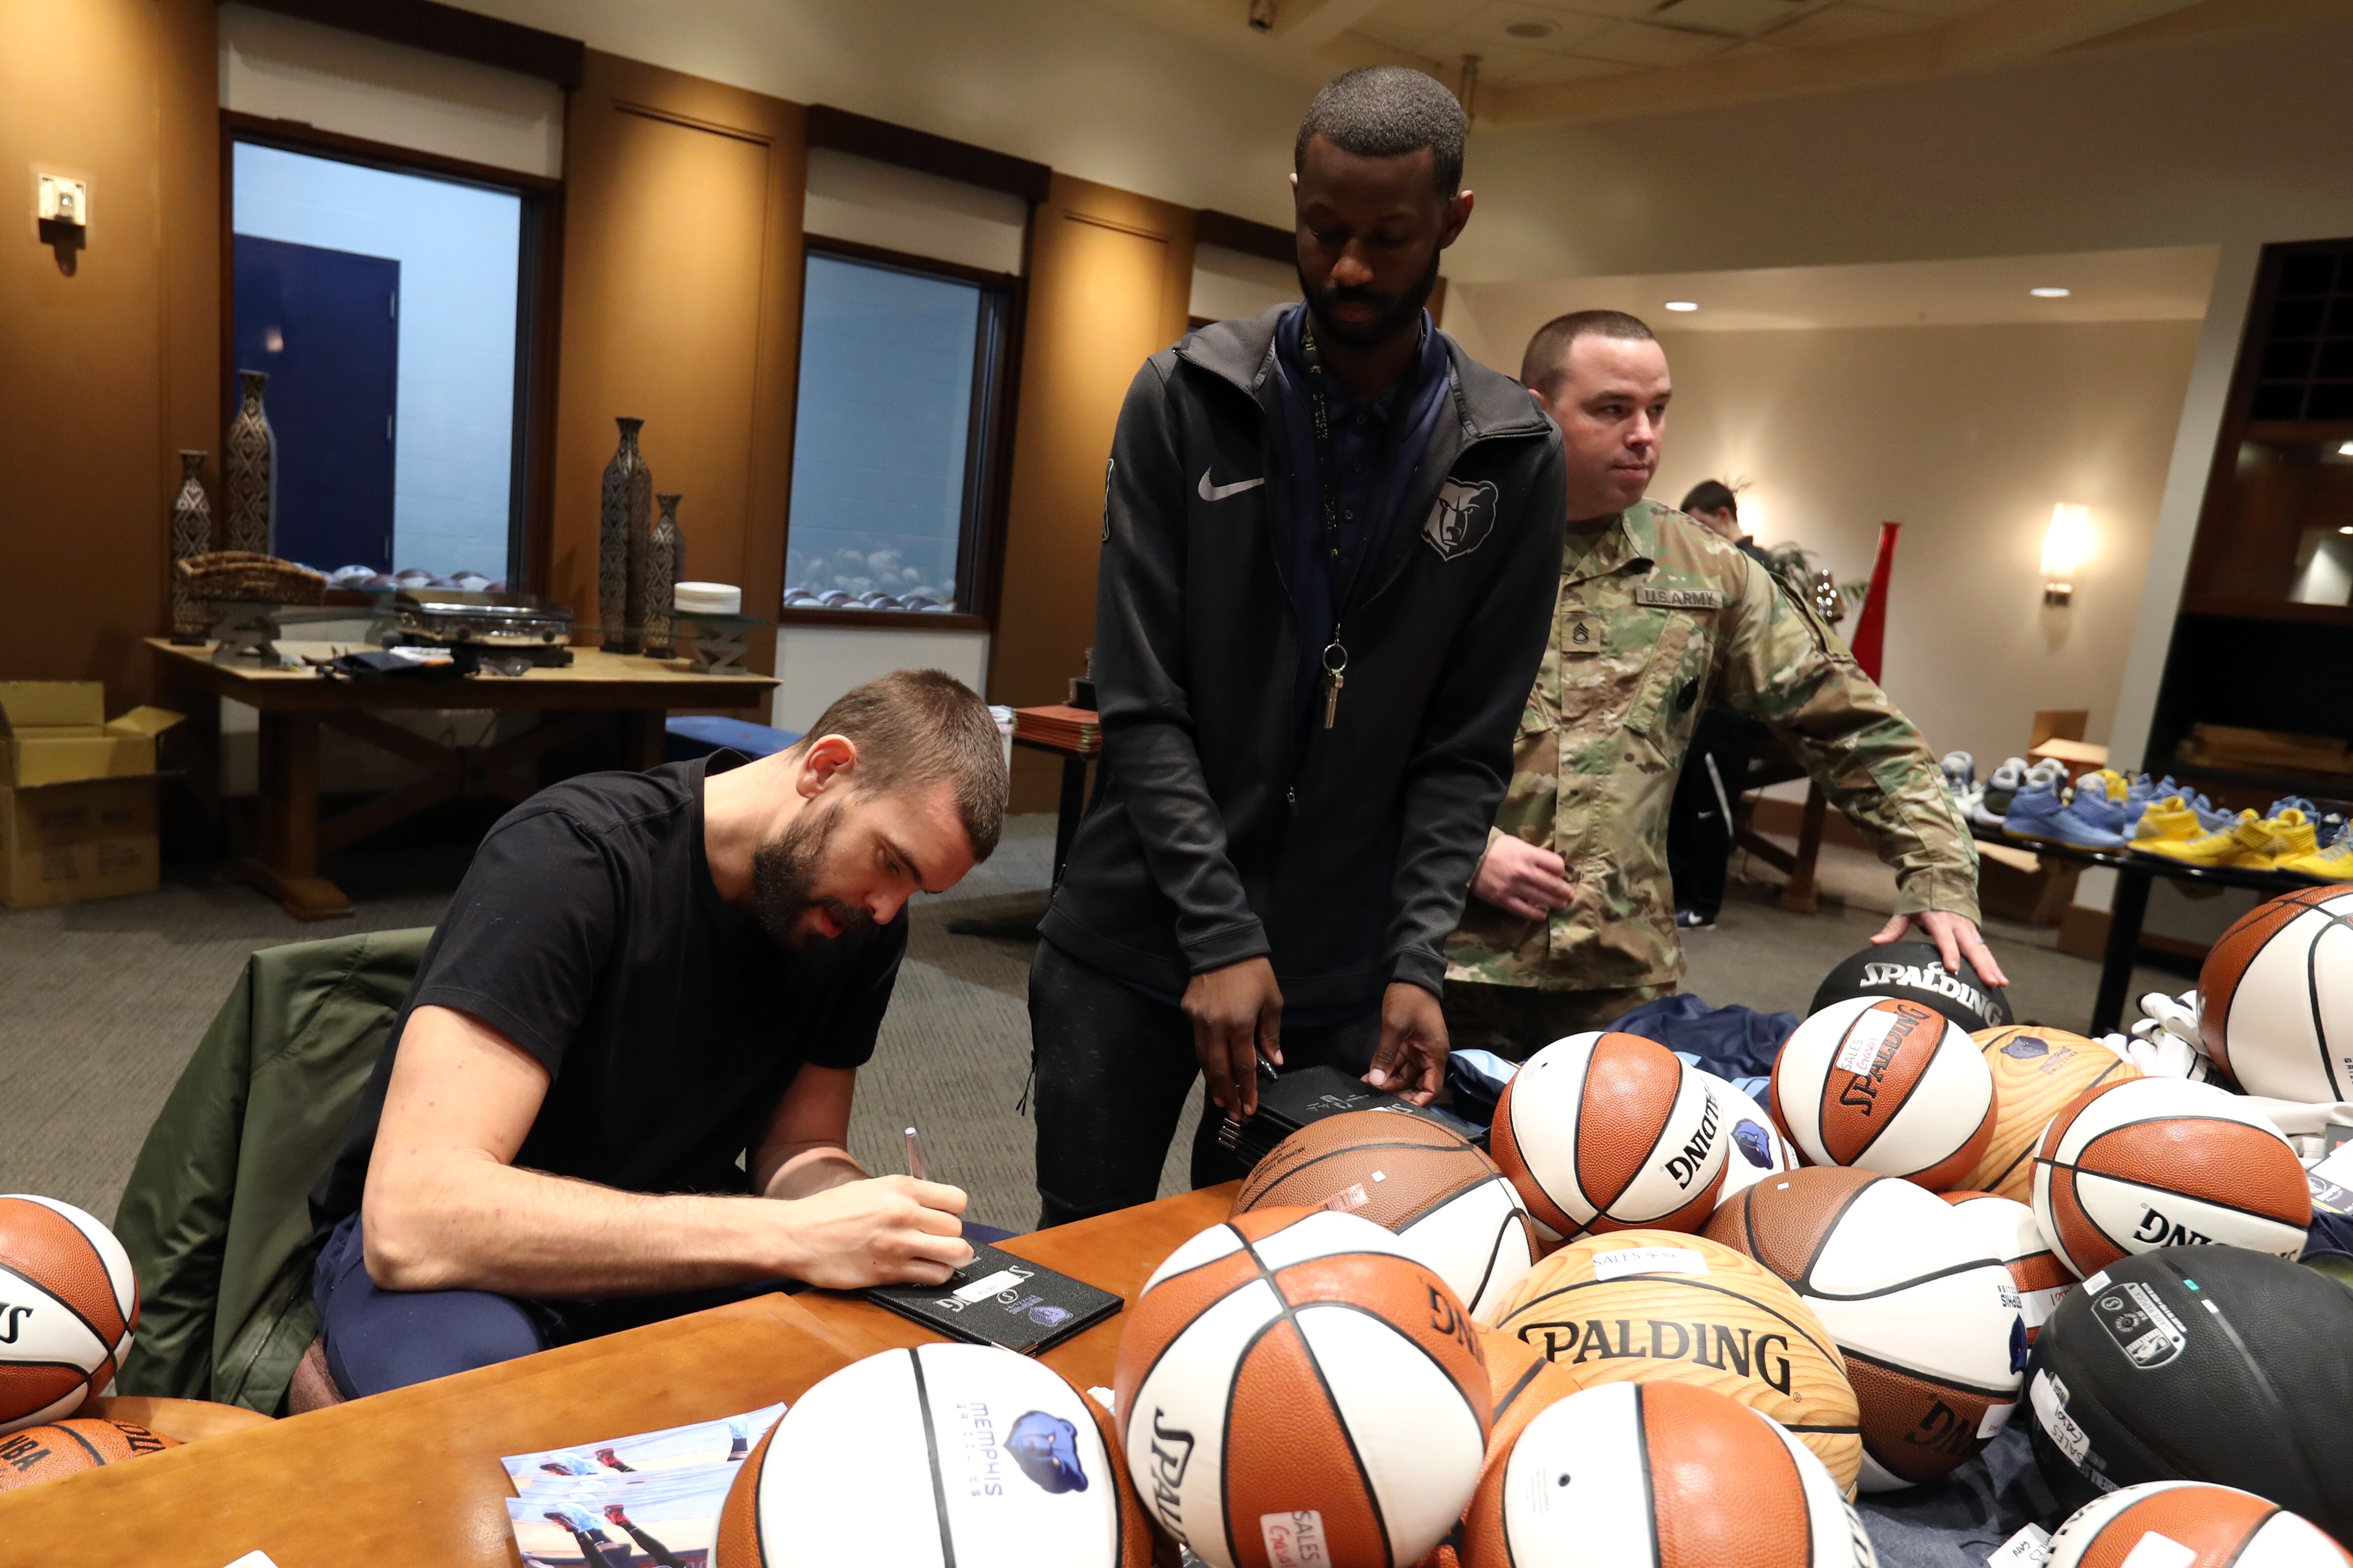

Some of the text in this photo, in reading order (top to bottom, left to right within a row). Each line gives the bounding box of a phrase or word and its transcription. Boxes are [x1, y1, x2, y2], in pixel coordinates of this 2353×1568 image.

[1672, 592, 1713, 605] ARMY
[1860, 962, 2004, 1028] SPALDING
[1839, 1003, 1932, 1117] SPALDING
[1841, 1039, 1863, 1071] SALES
[2039, 1046, 2071, 1072] MEMPHIS
[1664, 1079, 1719, 1191] ALDING
[1592, 1251, 1641, 1267] SALES
[2134, 1292, 2155, 1316] REPLICA
[2154, 1312, 2170, 1331] GAME
[971, 1403, 1002, 1497] MEMPHIS
[2051, 1424, 2085, 1465] SALES
[1292, 1510, 1321, 1561] SALES
